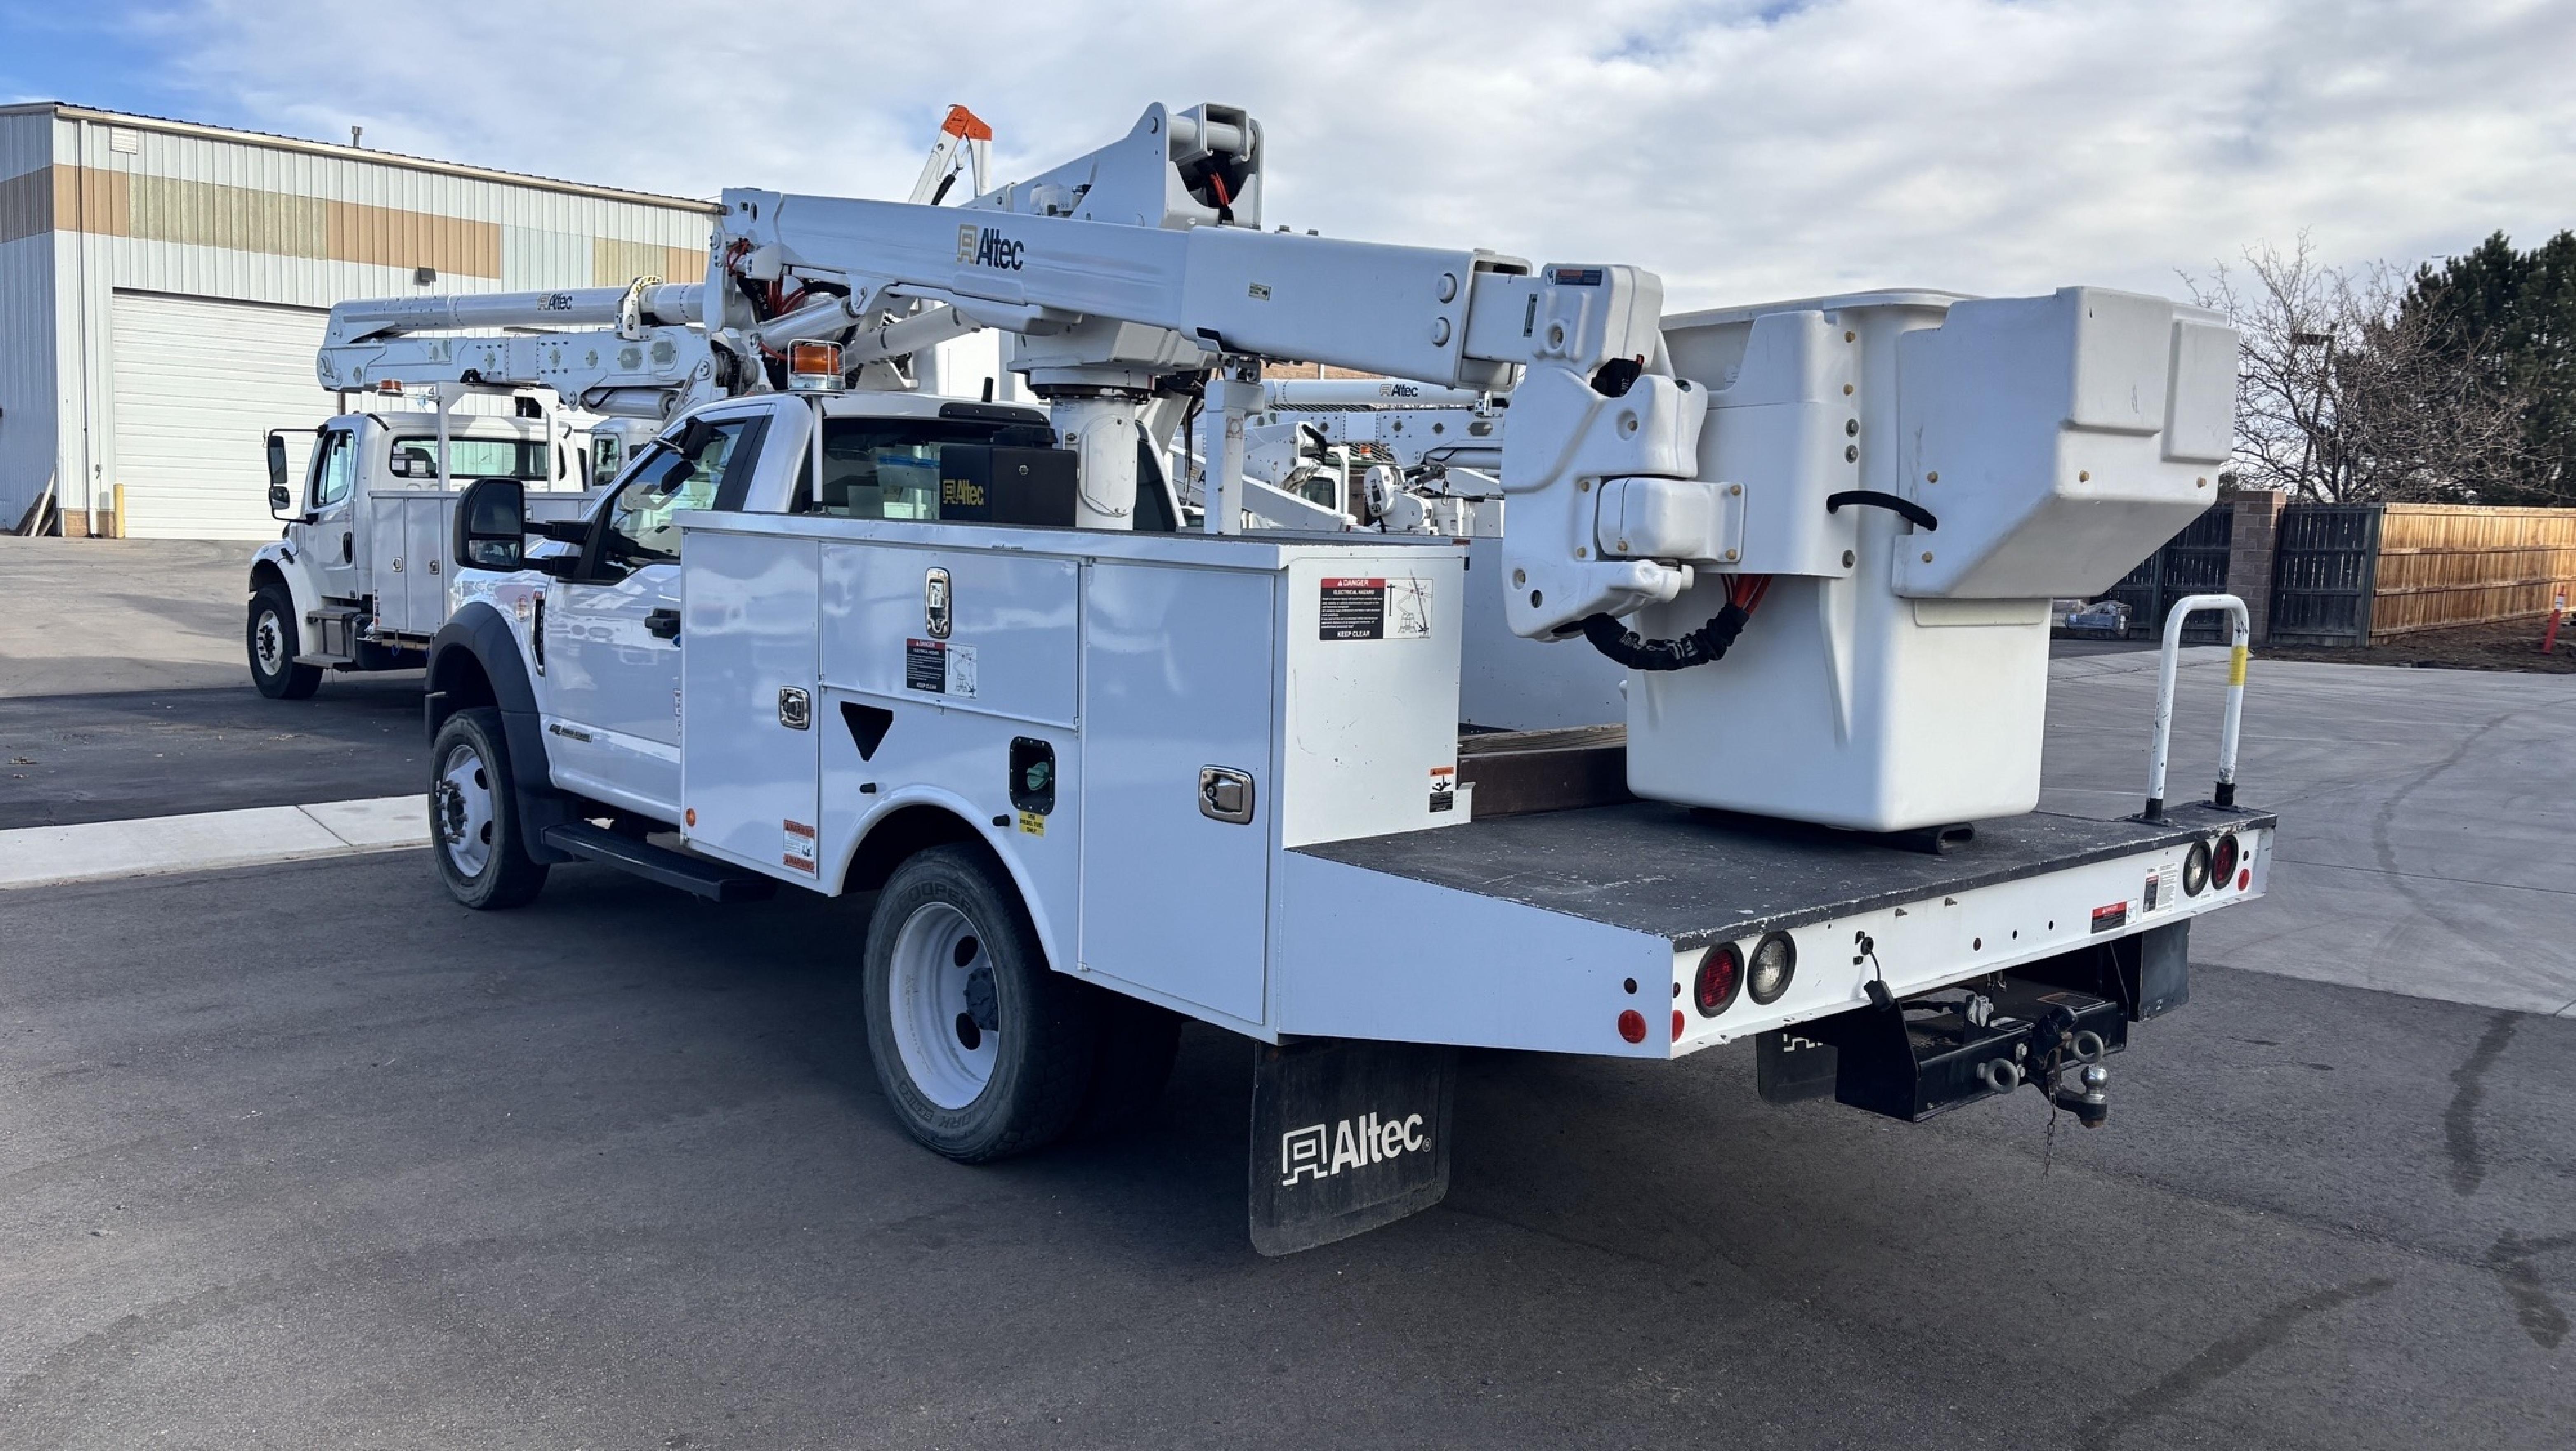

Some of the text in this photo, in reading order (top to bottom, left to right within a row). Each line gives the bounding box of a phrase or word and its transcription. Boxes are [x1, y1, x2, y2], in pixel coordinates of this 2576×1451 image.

[976, 228, 1024, 270] Altec
[548, 293, 572, 310] Altec
[1391, 384, 1418, 397] Altec
[957, 479, 984, 506] Altec
[897, 881, 972, 913] COOPER
